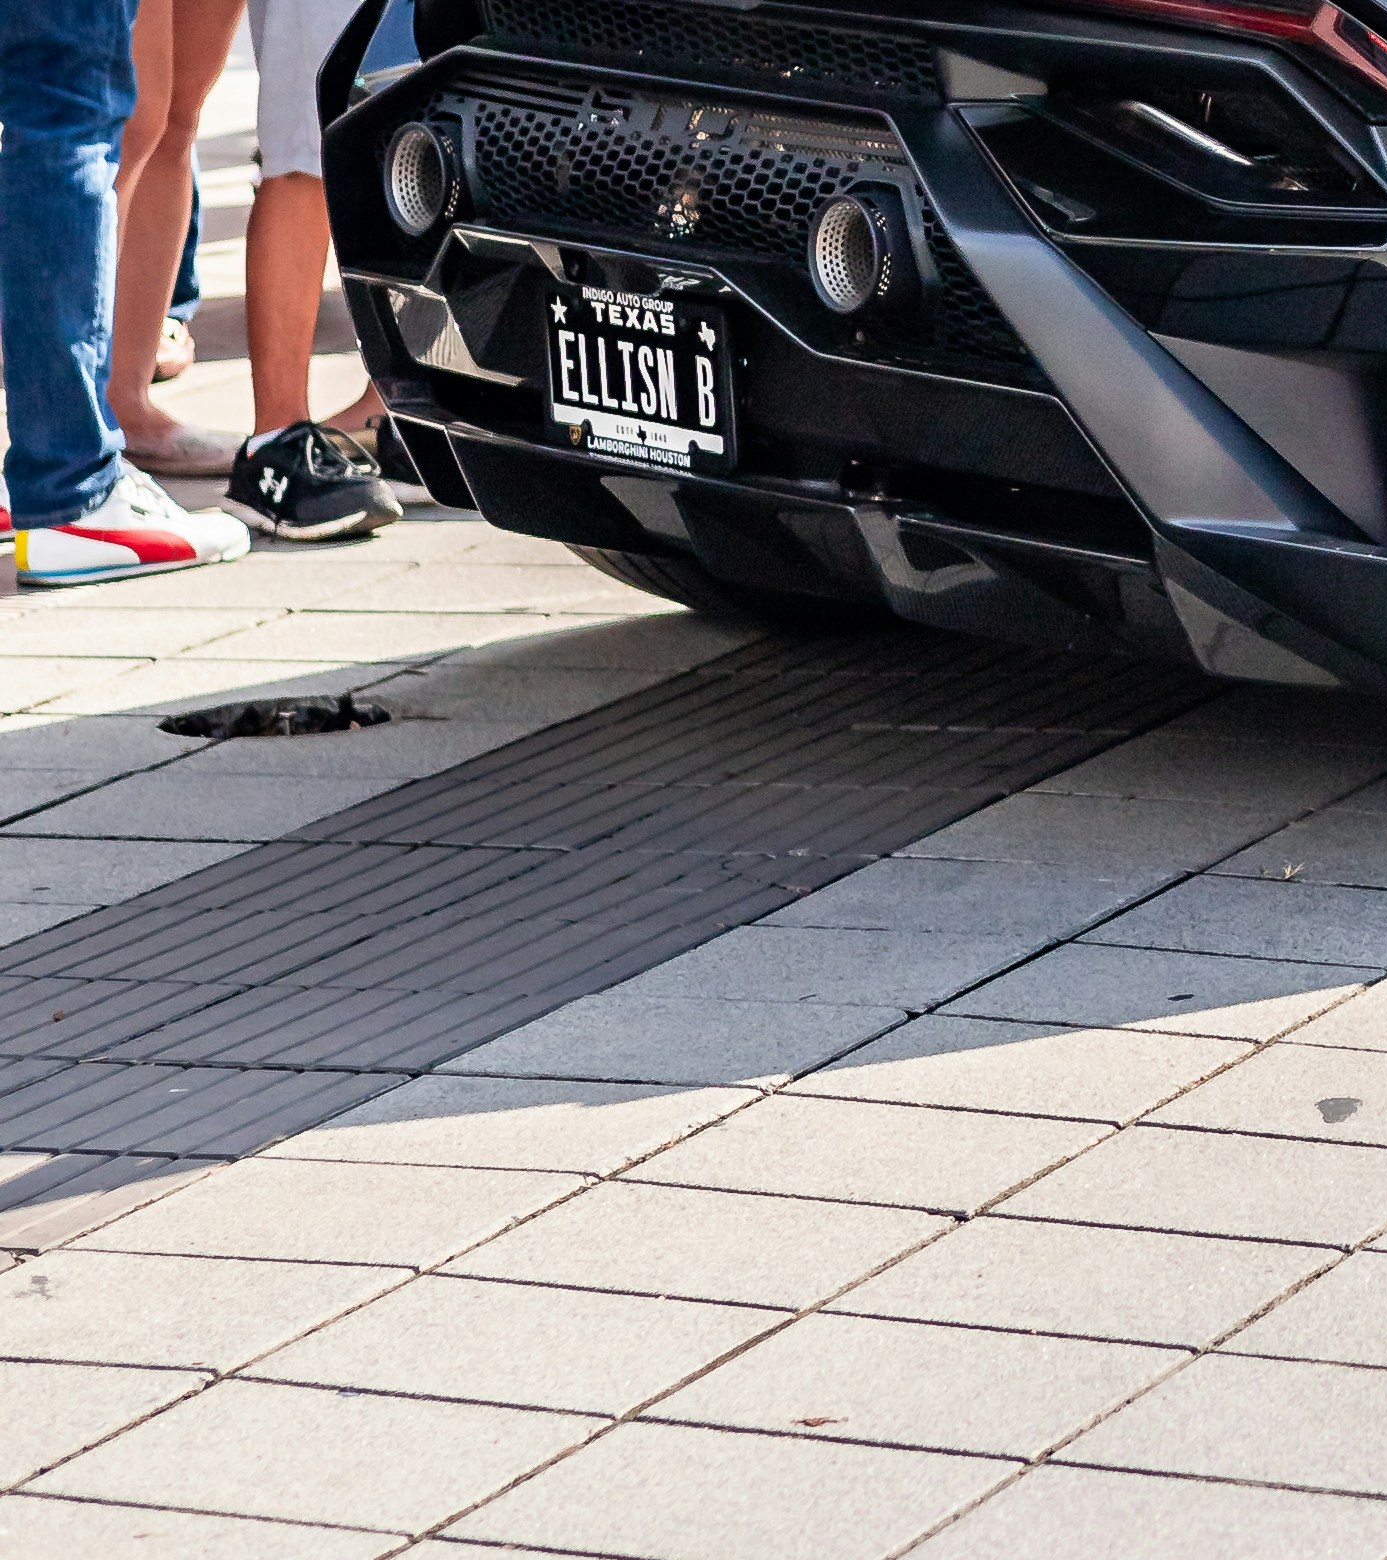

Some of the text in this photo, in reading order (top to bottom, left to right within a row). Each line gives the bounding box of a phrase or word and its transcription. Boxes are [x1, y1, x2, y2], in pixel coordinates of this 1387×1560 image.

[582, 286, 674, 313] INDIGO AUTO GROUP
[591, 301, 675, 335] TEXAS
[558, 330, 717, 428] ELLISN B
[586, 436, 690, 467] LAMBORGHINI HOUSTON
